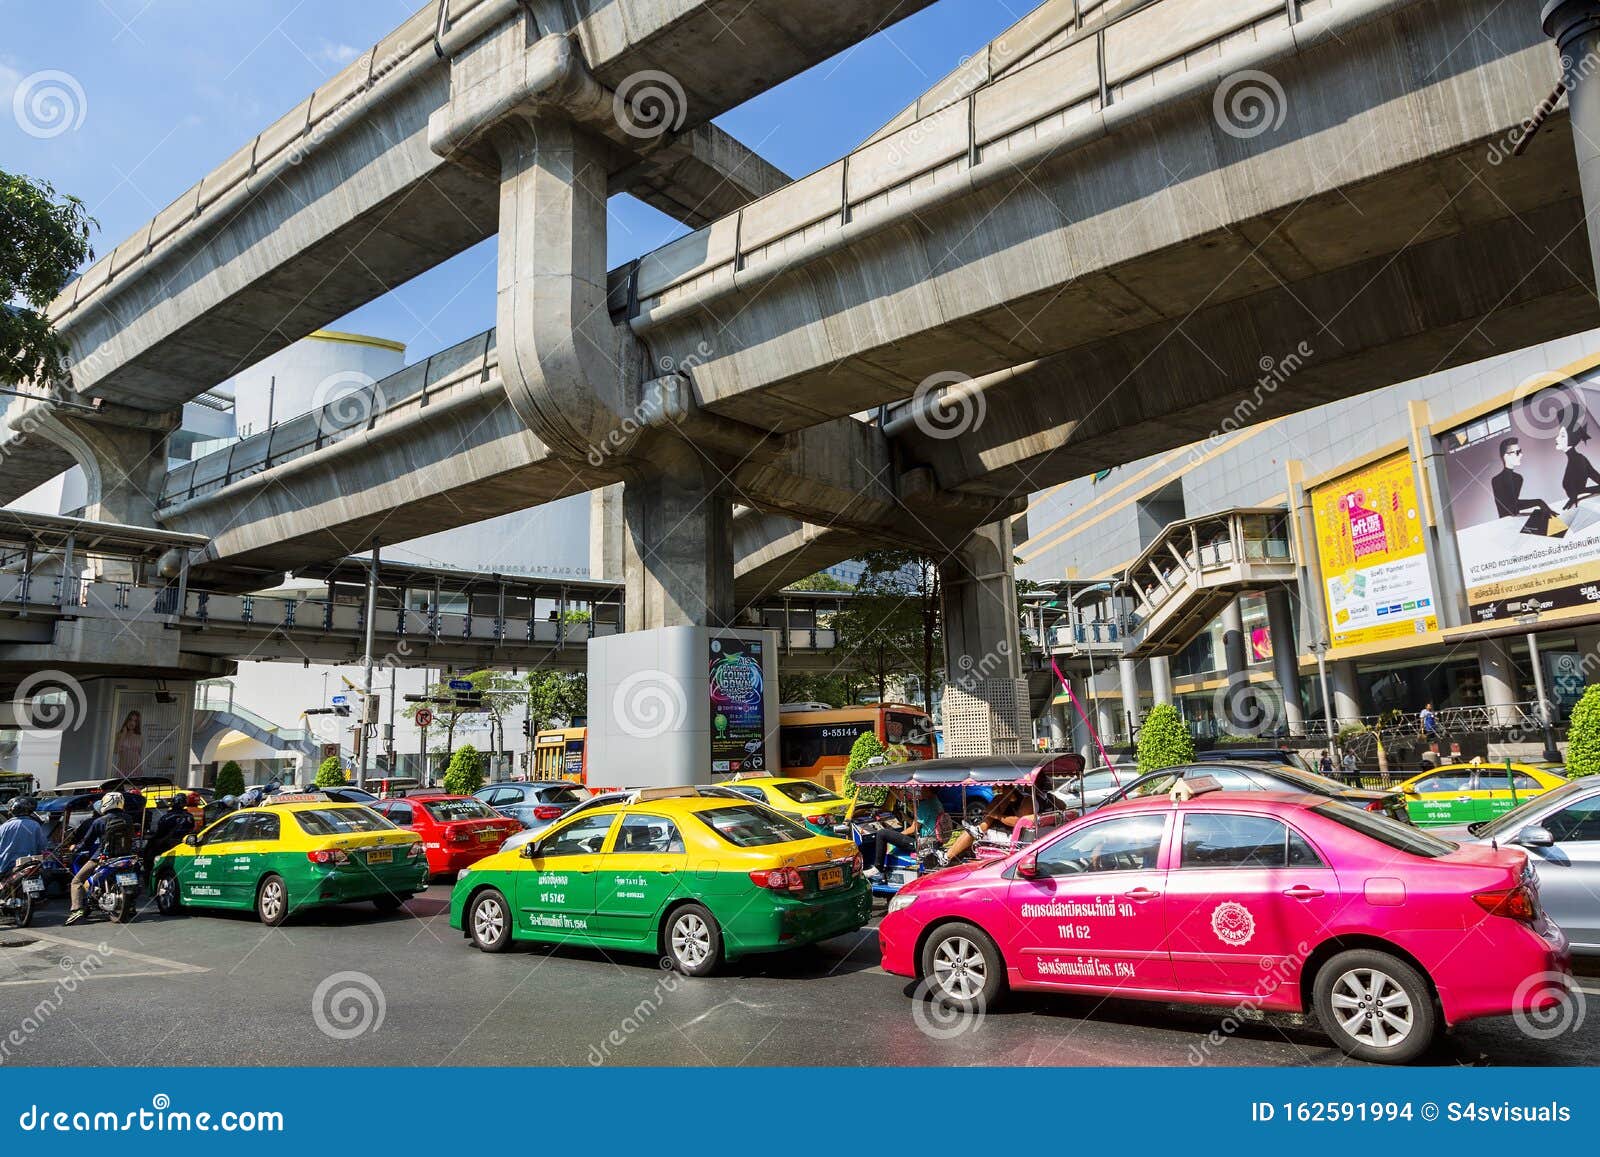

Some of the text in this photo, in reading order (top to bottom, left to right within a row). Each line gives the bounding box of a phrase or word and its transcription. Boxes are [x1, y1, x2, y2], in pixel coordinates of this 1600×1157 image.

[478, 564, 526, 574] BANGKOK
[530, 565, 549, 575] ART
[552, 567, 571, 576] AND
[1470, 566, 1481, 574] VIZ
[1481, 561, 1497, 572] CARD
[737, 656, 751, 665] AIS
[722, 671, 751, 680] COUNT
[723, 680, 752, 688] DOWN
[549, 893, 565, 904] 5742
[1075, 925, 1091, 939] 62
